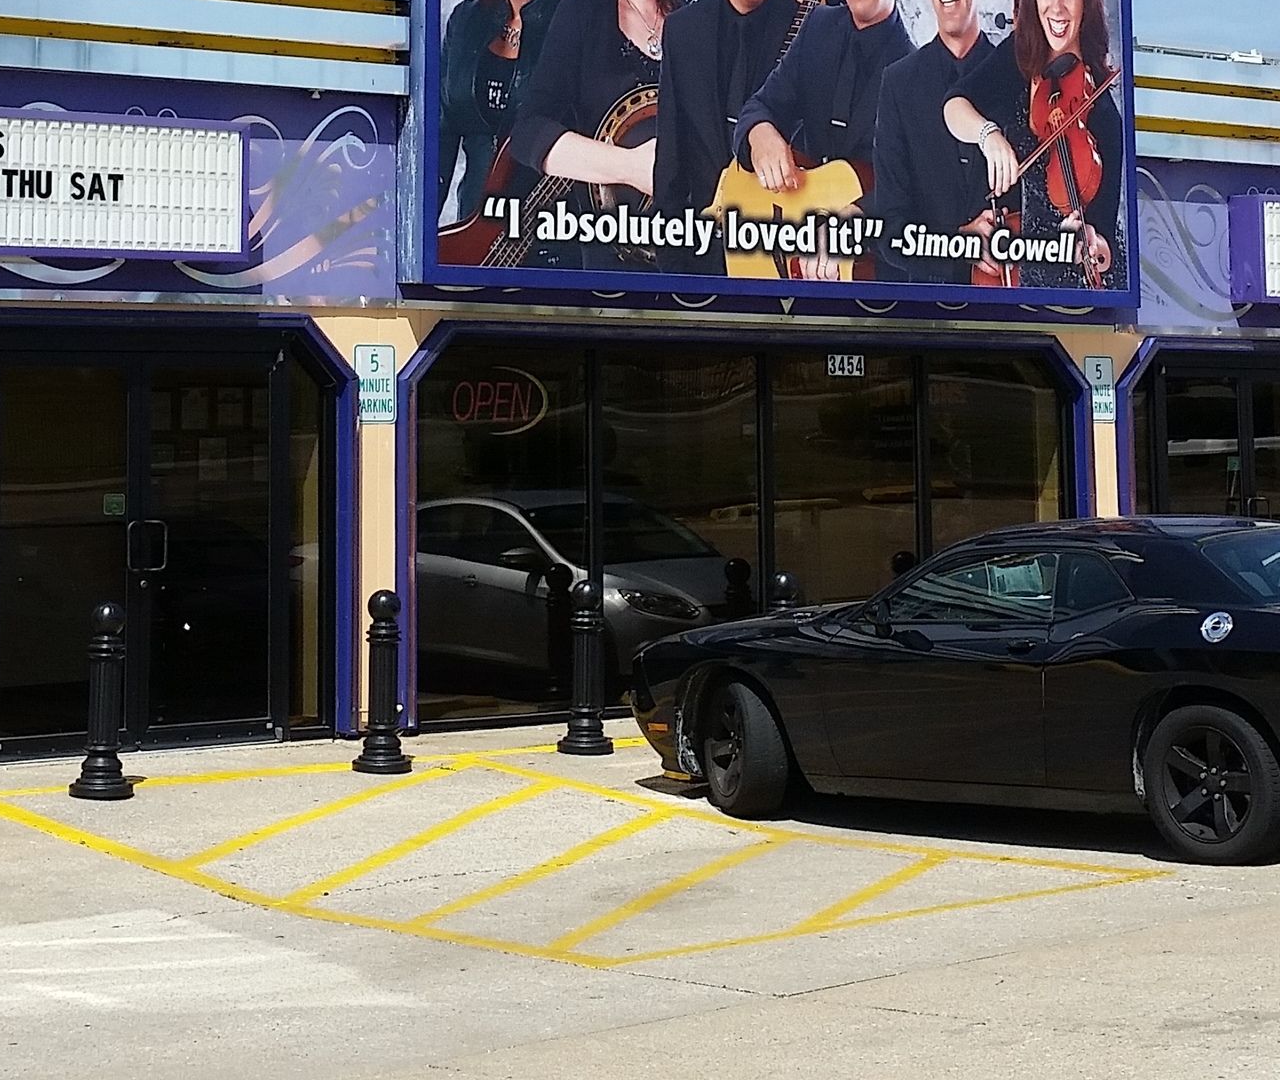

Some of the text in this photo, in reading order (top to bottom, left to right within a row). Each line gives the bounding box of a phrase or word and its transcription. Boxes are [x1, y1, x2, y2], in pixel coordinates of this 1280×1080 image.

[2, 167, 52, 199] THU
[70, 171, 124, 203] SAT
[536, 204, 713, 257] absolutely
[727, 210, 816, 255] loved
[891, 224, 981, 260] -Simon
[990, 228, 1075, 264] Cowell
[370, 353, 379, 373] 5
[829, 355, 863, 375] 3454
[1095, 363, 1103, 380] 5
[359, 378, 390, 393] MINUTE
[452, 380, 534, 422] OPEN
[1094, 401, 1113, 414] RKING
